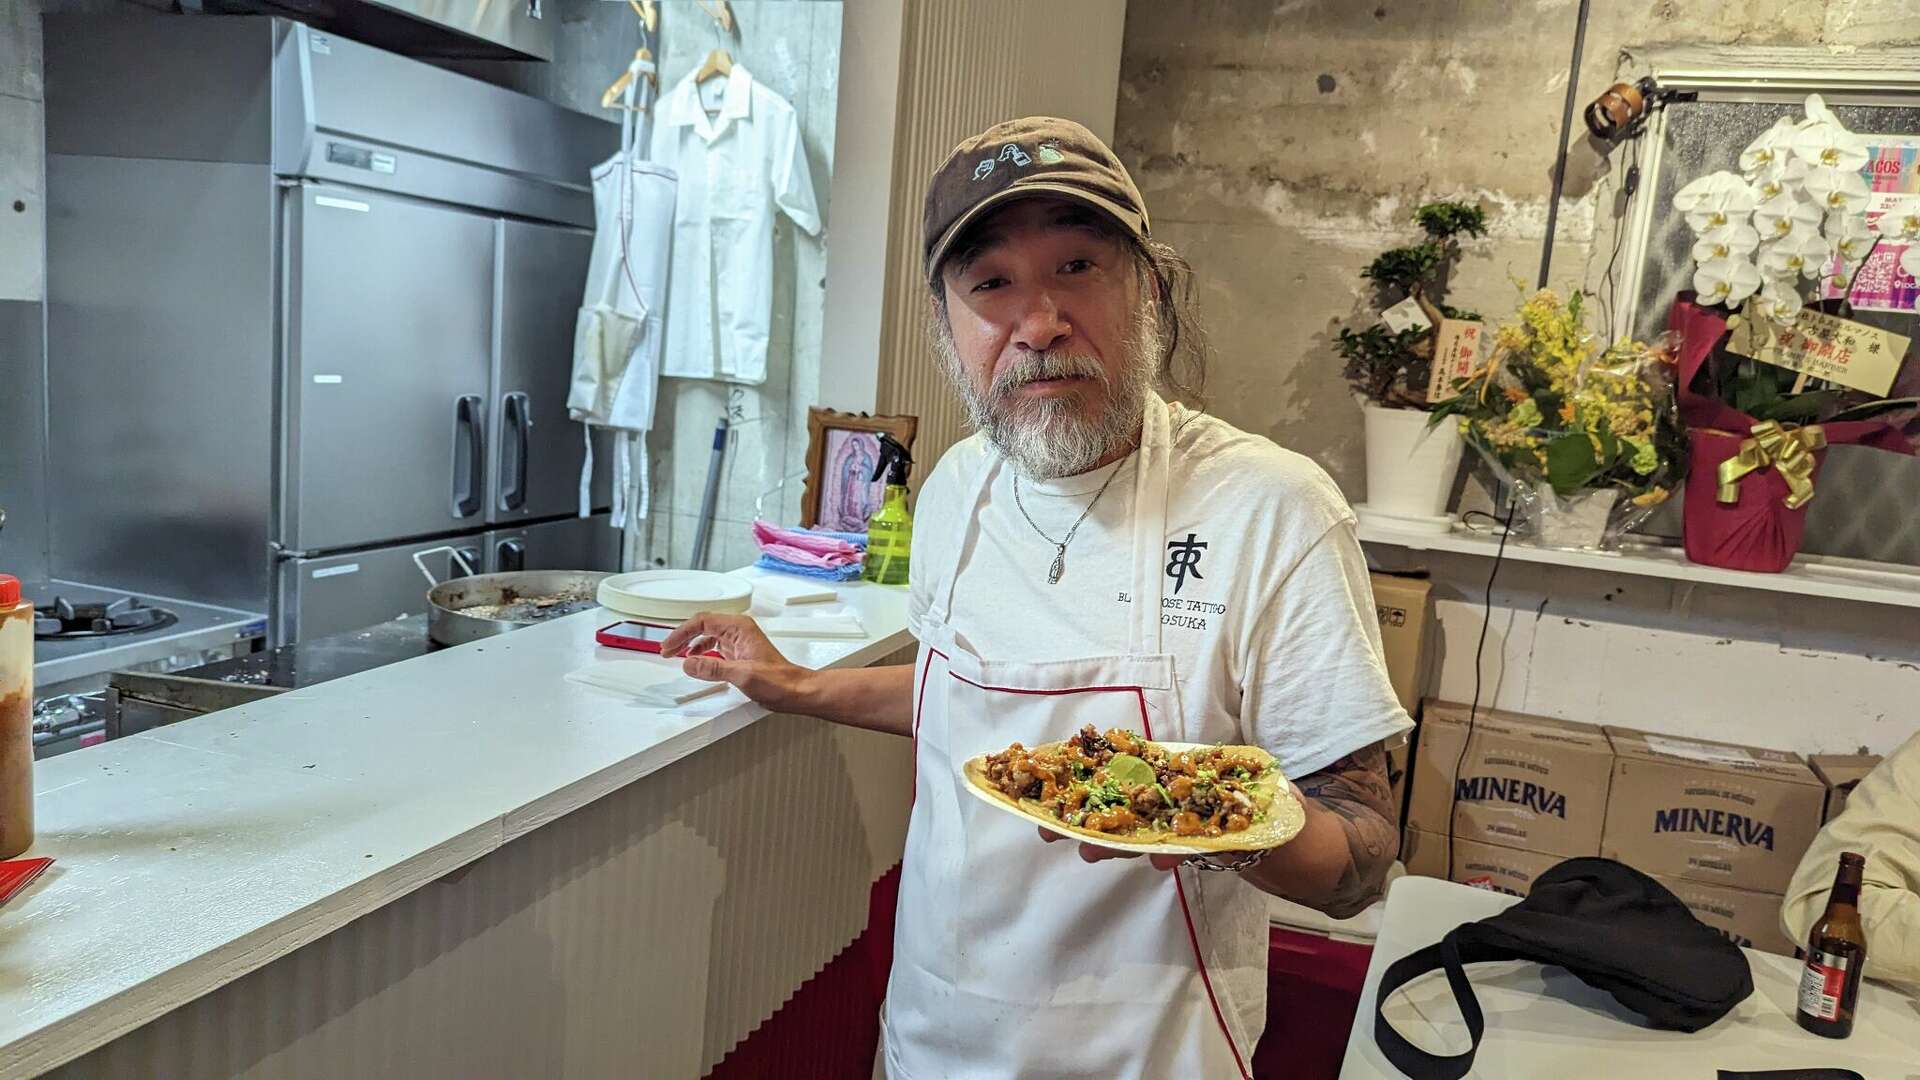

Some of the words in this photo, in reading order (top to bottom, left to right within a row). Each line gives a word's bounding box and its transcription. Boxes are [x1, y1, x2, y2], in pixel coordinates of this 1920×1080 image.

[1866, 160, 1901, 174] ACOS
[1161, 597, 1183, 609] OSE
[1161, 614, 1207, 630] OSUKA
[1456, 776, 1567, 819] MINERVA
[1654, 808, 1775, 851] MINERVA
